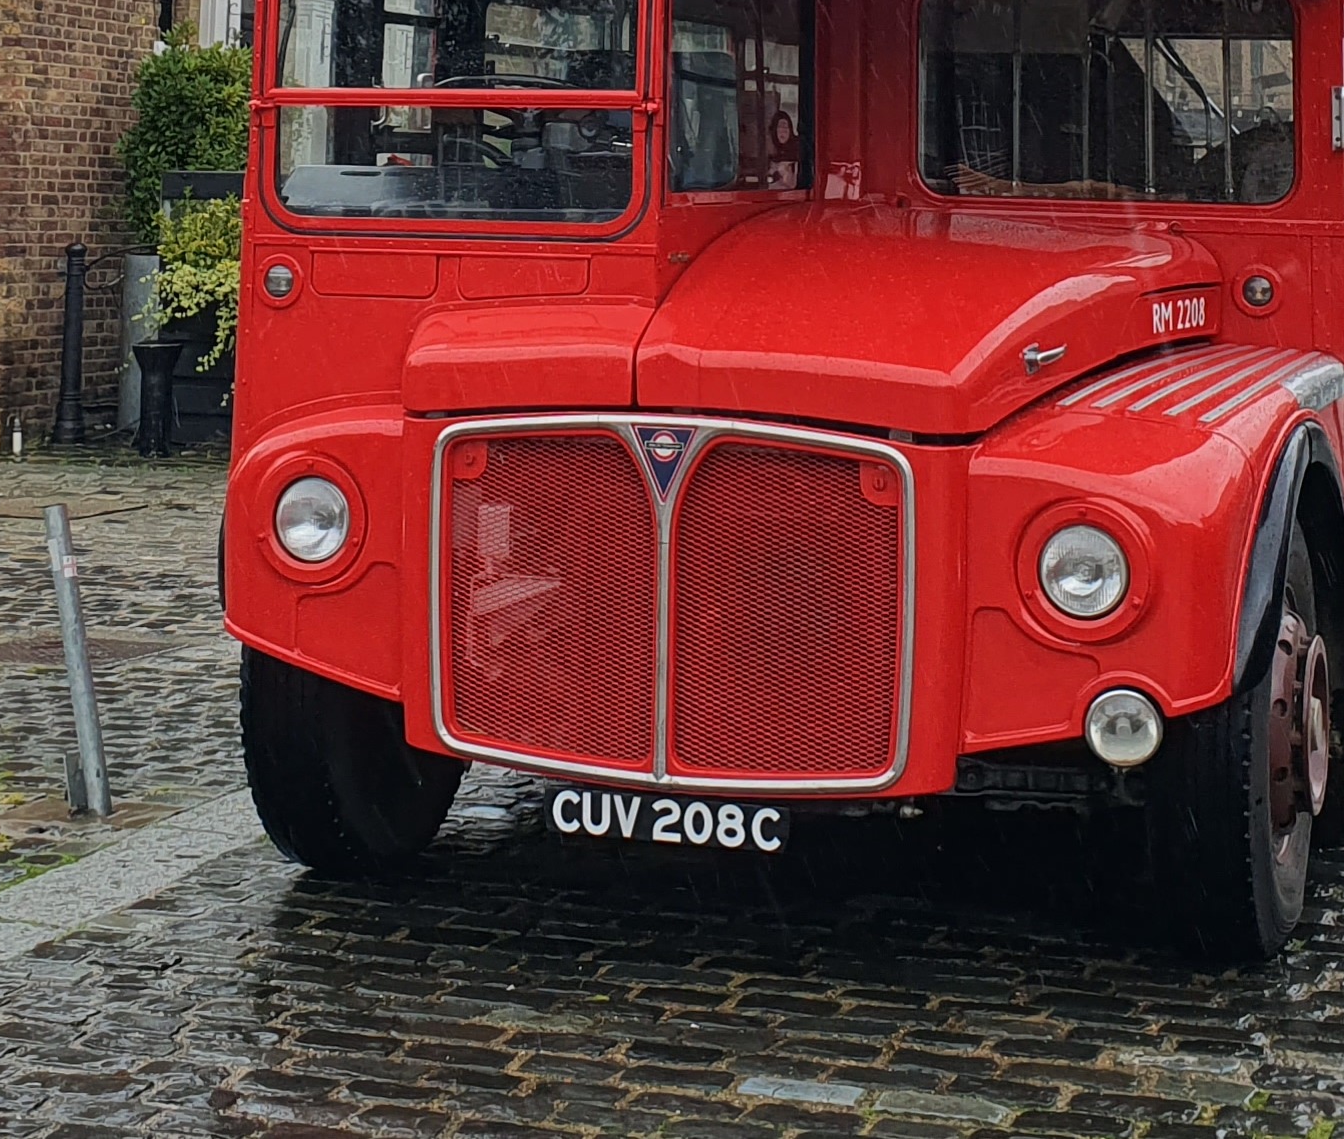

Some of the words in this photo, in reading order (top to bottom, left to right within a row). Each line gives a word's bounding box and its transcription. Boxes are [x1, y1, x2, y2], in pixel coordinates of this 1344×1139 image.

[1153, 301, 1173, 334] RM
[1177, 297, 1205, 329] 2208
[552, 790, 641, 838] CUV
[652, 799, 781, 851] 208C
